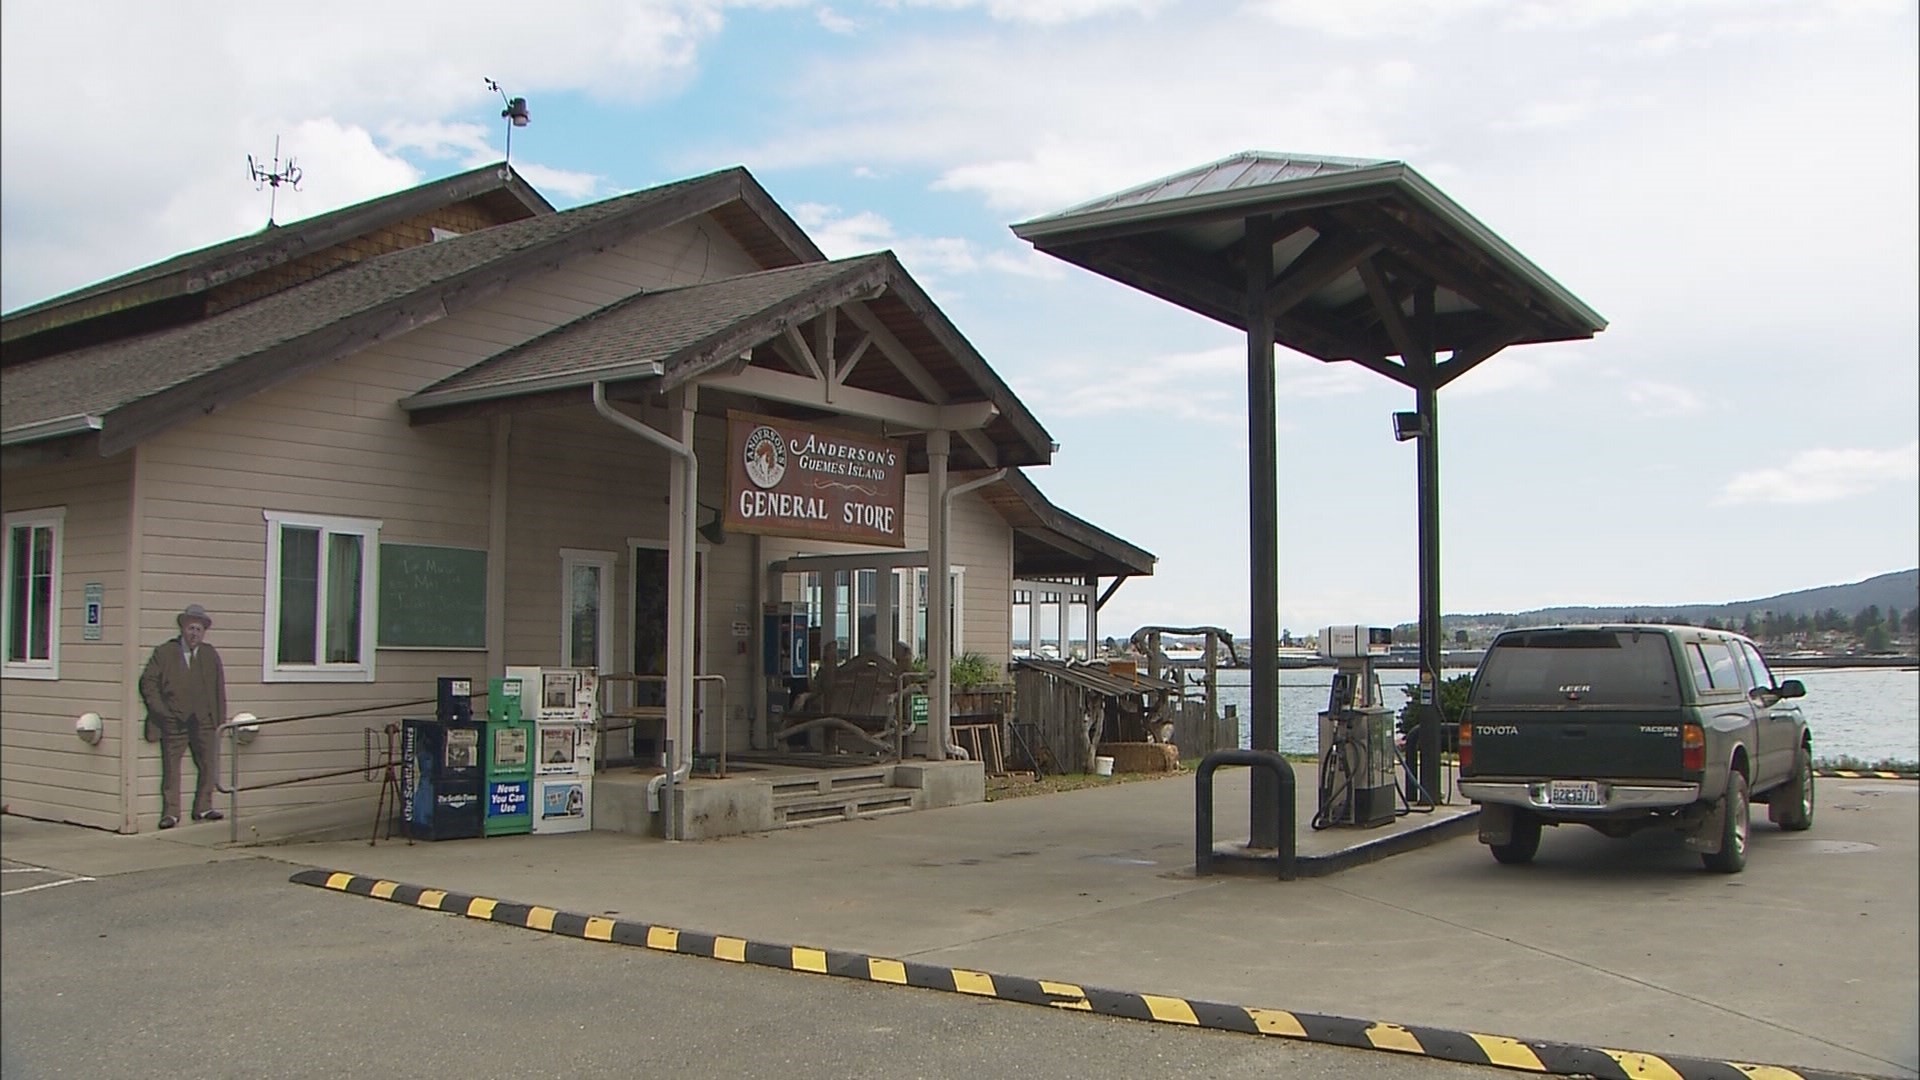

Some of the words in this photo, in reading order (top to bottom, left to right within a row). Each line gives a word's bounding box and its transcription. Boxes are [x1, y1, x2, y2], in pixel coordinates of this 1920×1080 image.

[790, 434, 896, 467] ANDERSON'S
[799, 455, 845, 475] GUEMES
[848, 462, 885, 481] ISLAND
[740, 489, 829, 520] GENERAL
[843, 502, 895, 535] STORE
[1476, 725, 1519, 735] TOYOTA
[1640, 725, 1680, 733] TACOMA
[496, 784, 520, 793] News
[491, 794, 508, 804] You
[508, 793, 526, 803] Can
[500, 803, 517, 813] Use
